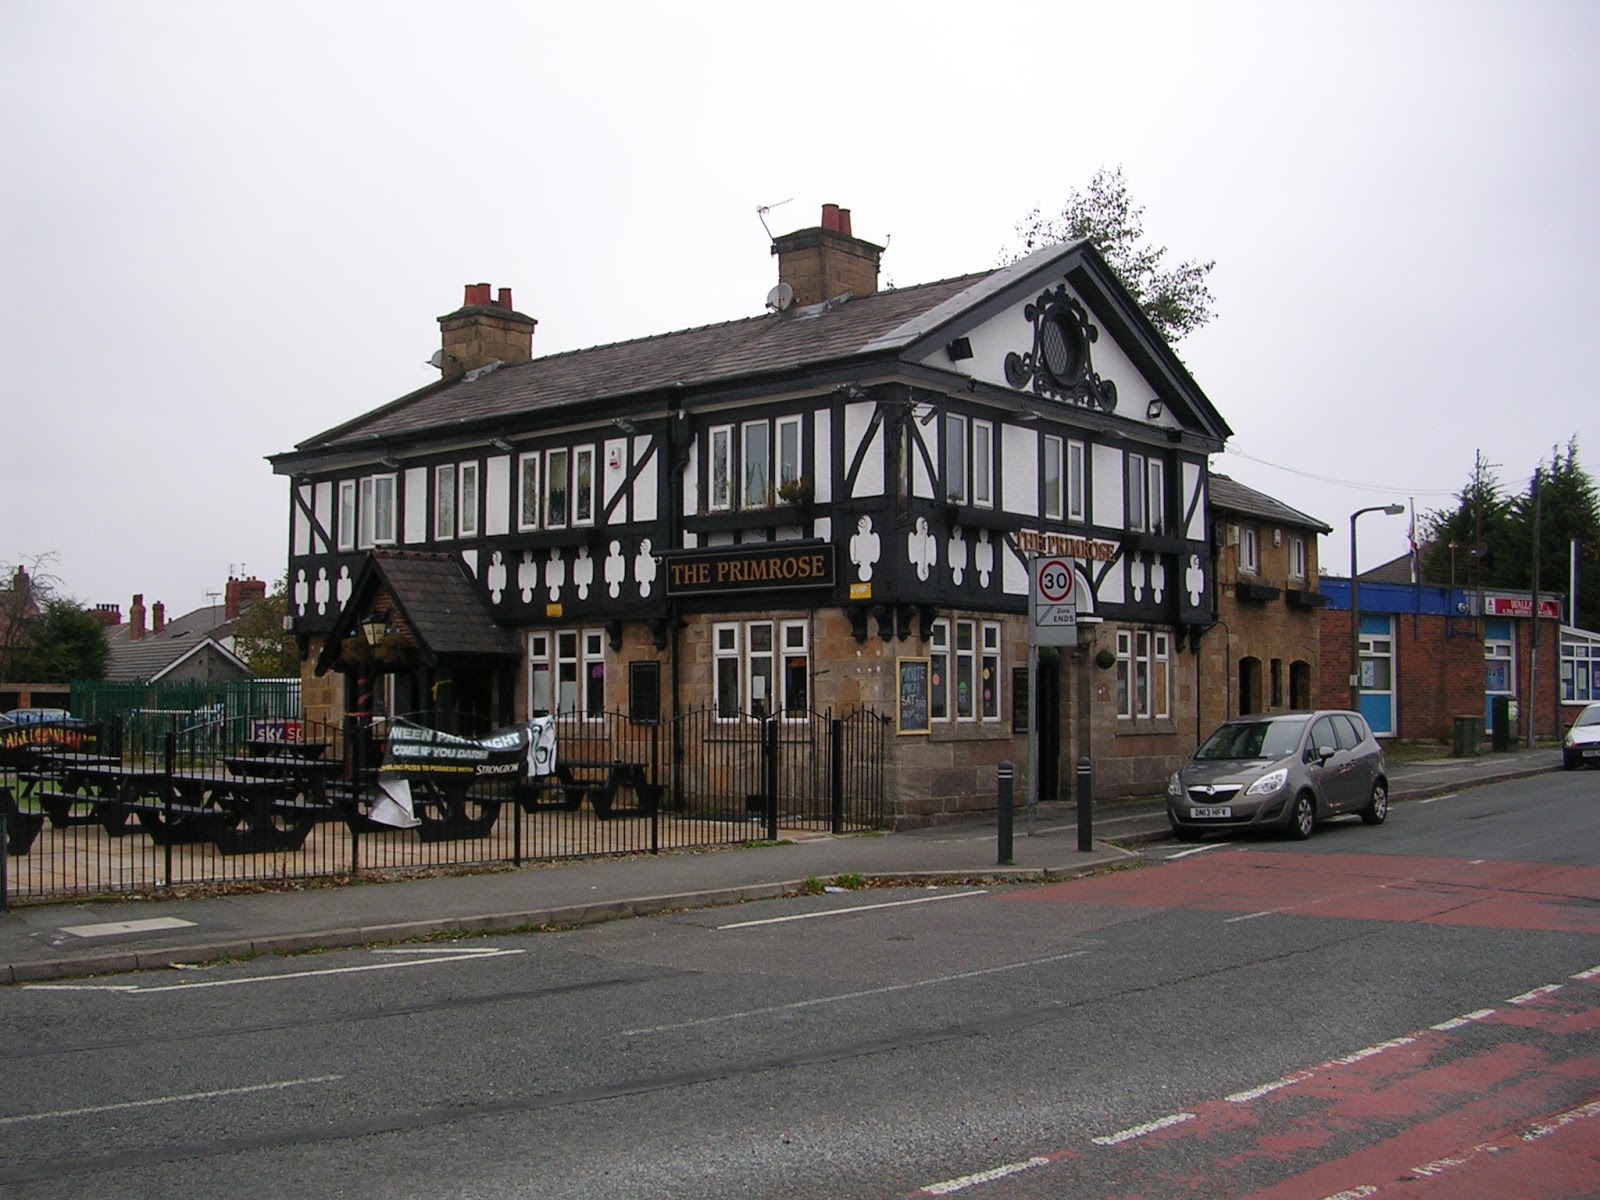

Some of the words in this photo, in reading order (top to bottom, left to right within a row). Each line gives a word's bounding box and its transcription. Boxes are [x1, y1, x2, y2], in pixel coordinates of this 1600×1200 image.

[1016, 532, 1047, 553] THE
[1047, 535, 1116, 562] PRIMROSE
[671, 563, 711, 586] THE
[717, 555, 825, 582] PRIMROSE
[1044, 573, 1068, 590] 30
[1053, 615, 1074, 623] ENDS
[257, 725, 283, 741] sky
[392, 744, 419, 756] COME
[420, 746, 431, 757] IF
[432, 747, 457, 758] YOU
[475, 763, 519, 775] STRONGBOW
